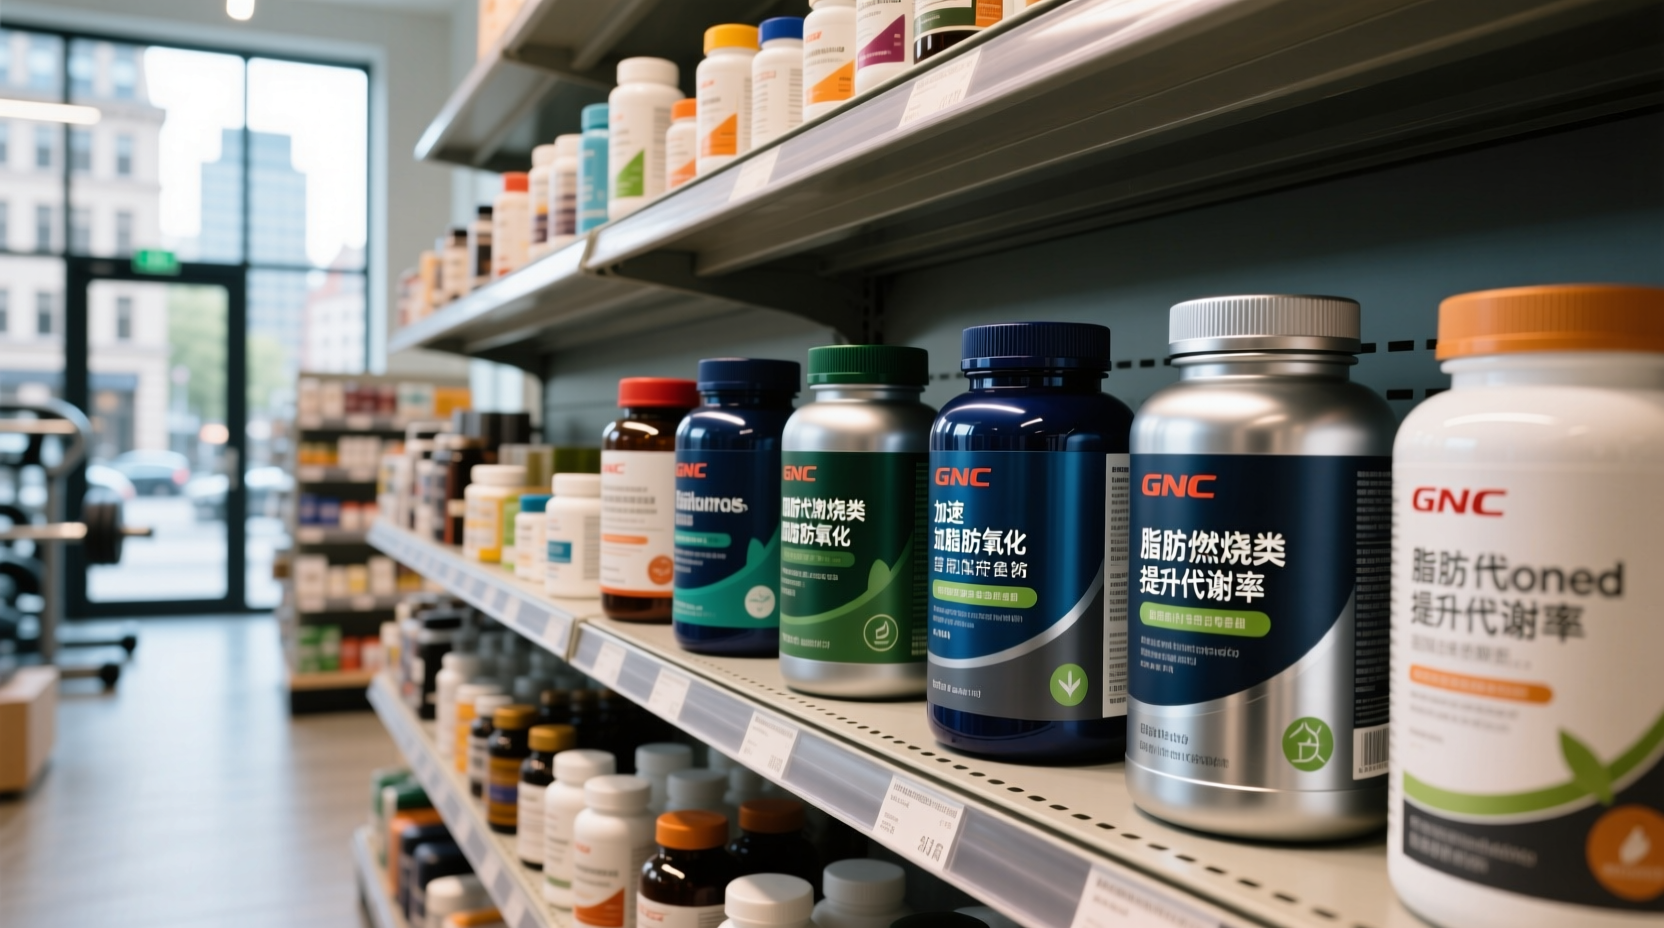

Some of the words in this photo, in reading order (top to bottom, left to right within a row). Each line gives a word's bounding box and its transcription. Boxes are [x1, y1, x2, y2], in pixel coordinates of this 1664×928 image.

[676, 463, 707, 479] GNC
[783, 465, 817, 482] GNC
[935, 467, 991, 487] GNC
[1141, 473, 1217, 499] GNC
[934, 499, 964, 525] 加速
[1412, 486, 1507, 517] GNC
[1140, 527, 1286, 568] 脂肪燃烧类
[1139, 565, 1265, 604] 提升代谢率
[1411, 591, 1586, 643] 提升代谢率
